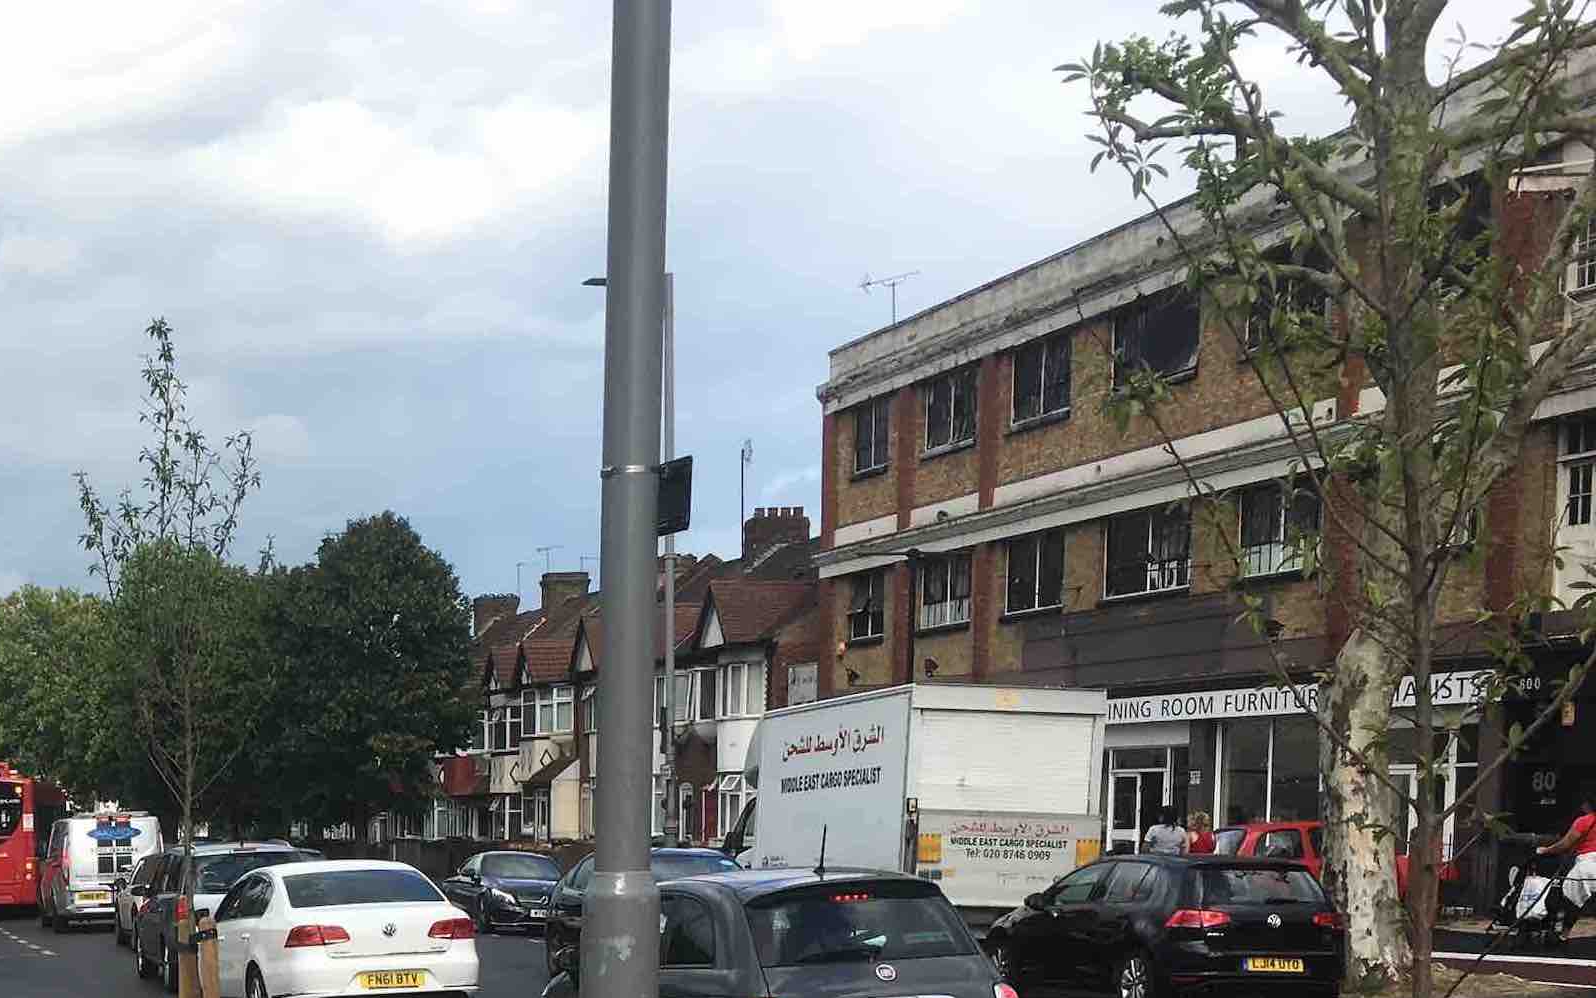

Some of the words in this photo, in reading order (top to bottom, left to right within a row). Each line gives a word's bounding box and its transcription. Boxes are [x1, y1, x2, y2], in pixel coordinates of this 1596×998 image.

[1161, 695, 1214, 717] ROOM
[781, 776, 803, 794] MIDDLE
[804, 774, 820, 792] EAST
[820, 771, 842, 789] CARGO
[844, 767, 882, 788] SPECIALIST
[950, 837, 977, 846] MIDDLE
[979, 838, 997, 847] EAST
[999, 838, 1024, 848] CARGO
[1026, 839, 1068, 849] SPECIALIST
